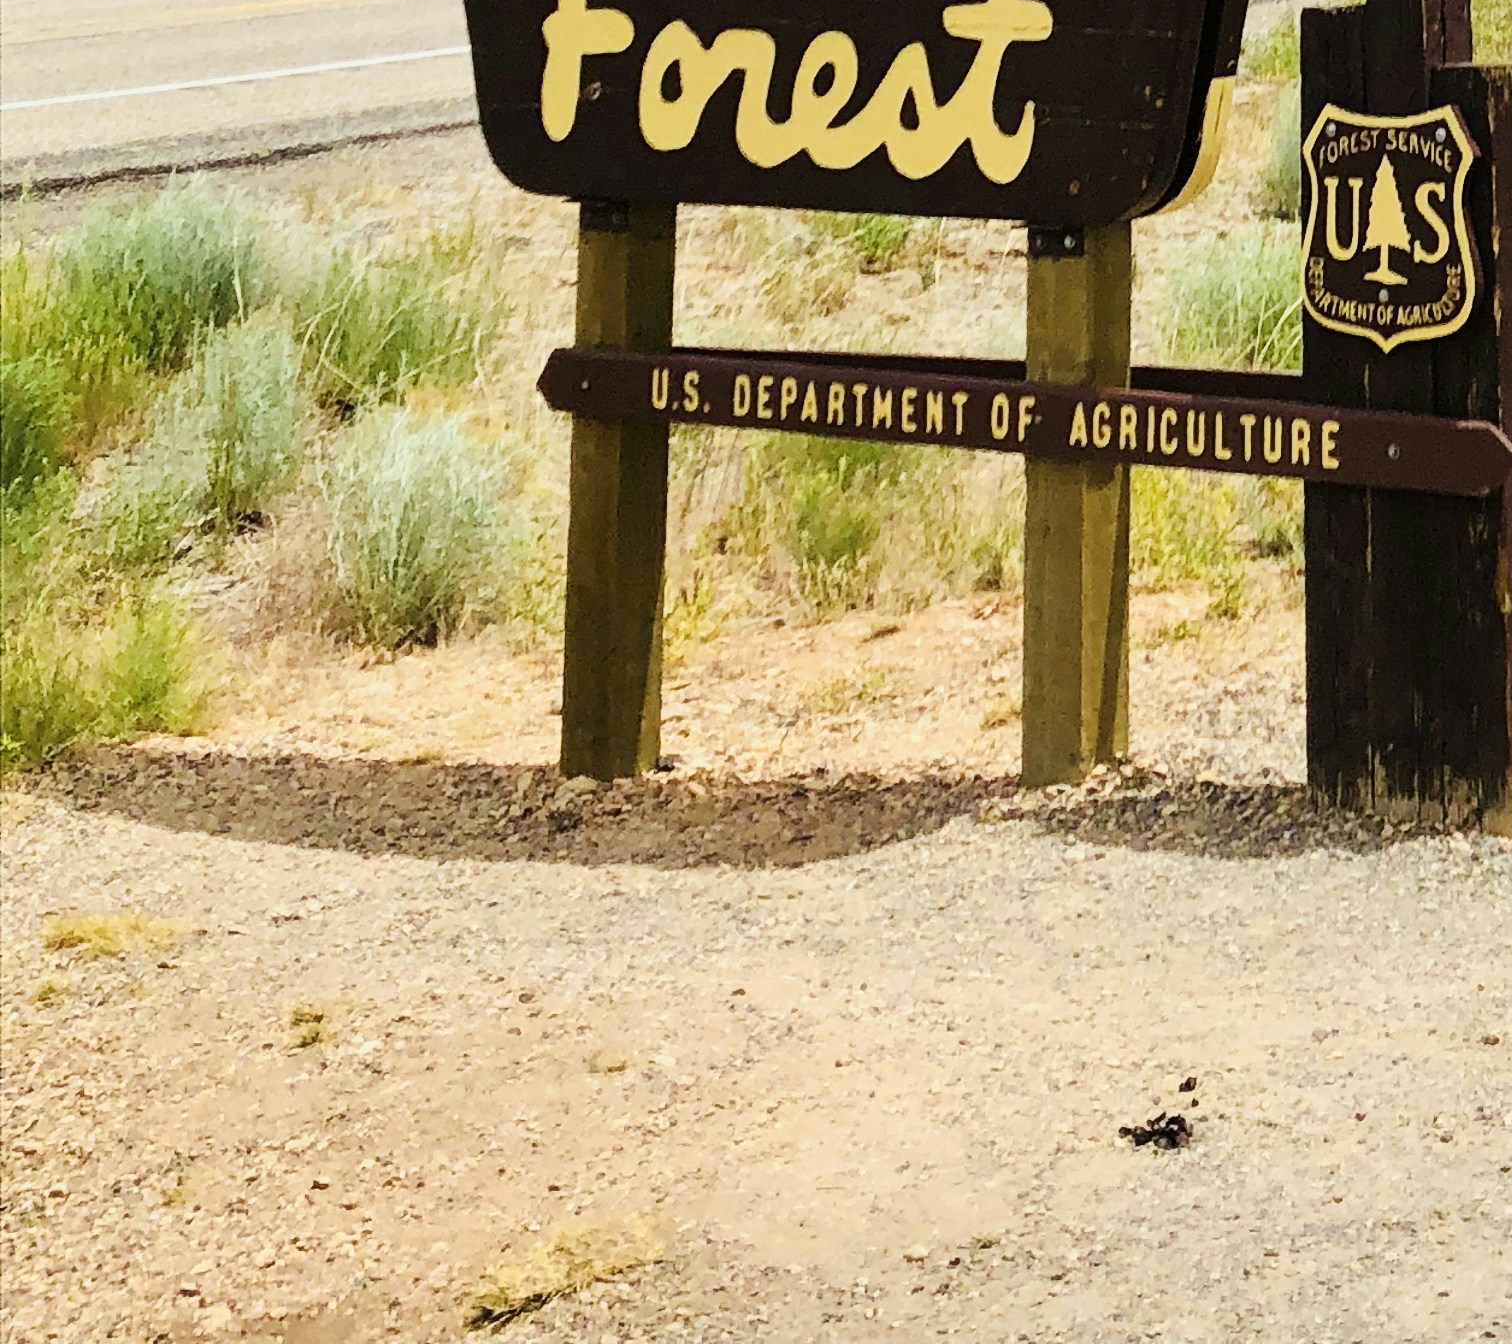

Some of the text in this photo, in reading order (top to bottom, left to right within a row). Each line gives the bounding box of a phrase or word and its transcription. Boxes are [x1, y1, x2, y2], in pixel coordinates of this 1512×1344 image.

[1319, 128, 1453, 174] FOREST SERVICE
[1376, 305, 1395, 326] OF
[651, 368, 1341, 470] U.S. DEPARTMENT OF AGRICULTURE
